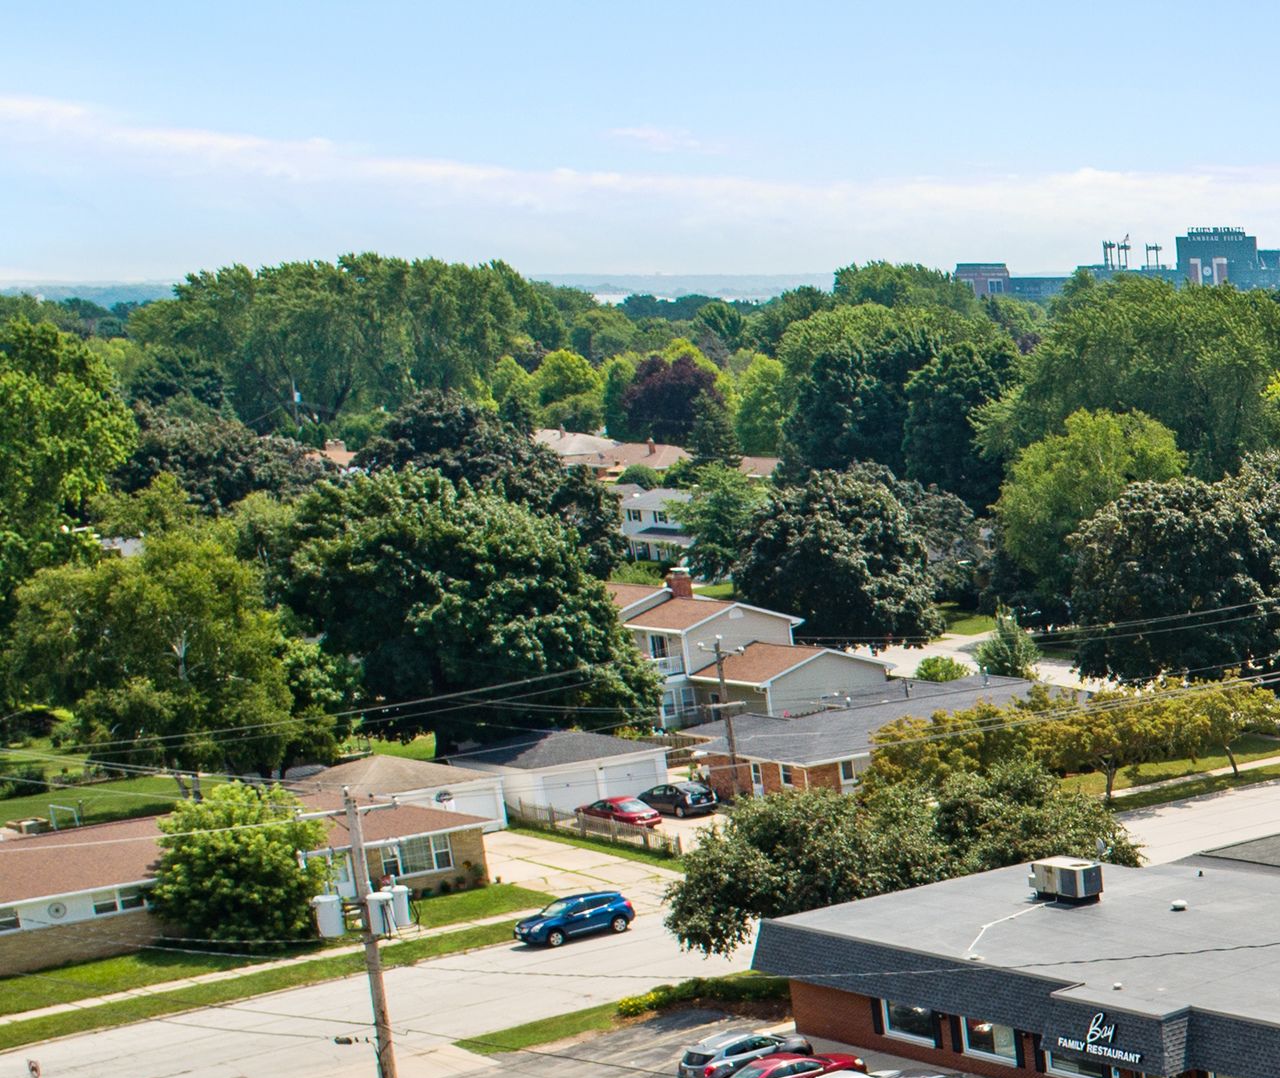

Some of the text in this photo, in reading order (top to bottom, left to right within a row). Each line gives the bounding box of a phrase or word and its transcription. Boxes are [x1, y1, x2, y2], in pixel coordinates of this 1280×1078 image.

[1086, 1012, 1115, 1043] Bay
[1058, 1037, 1141, 1064] FAMILY RESTAURANT
